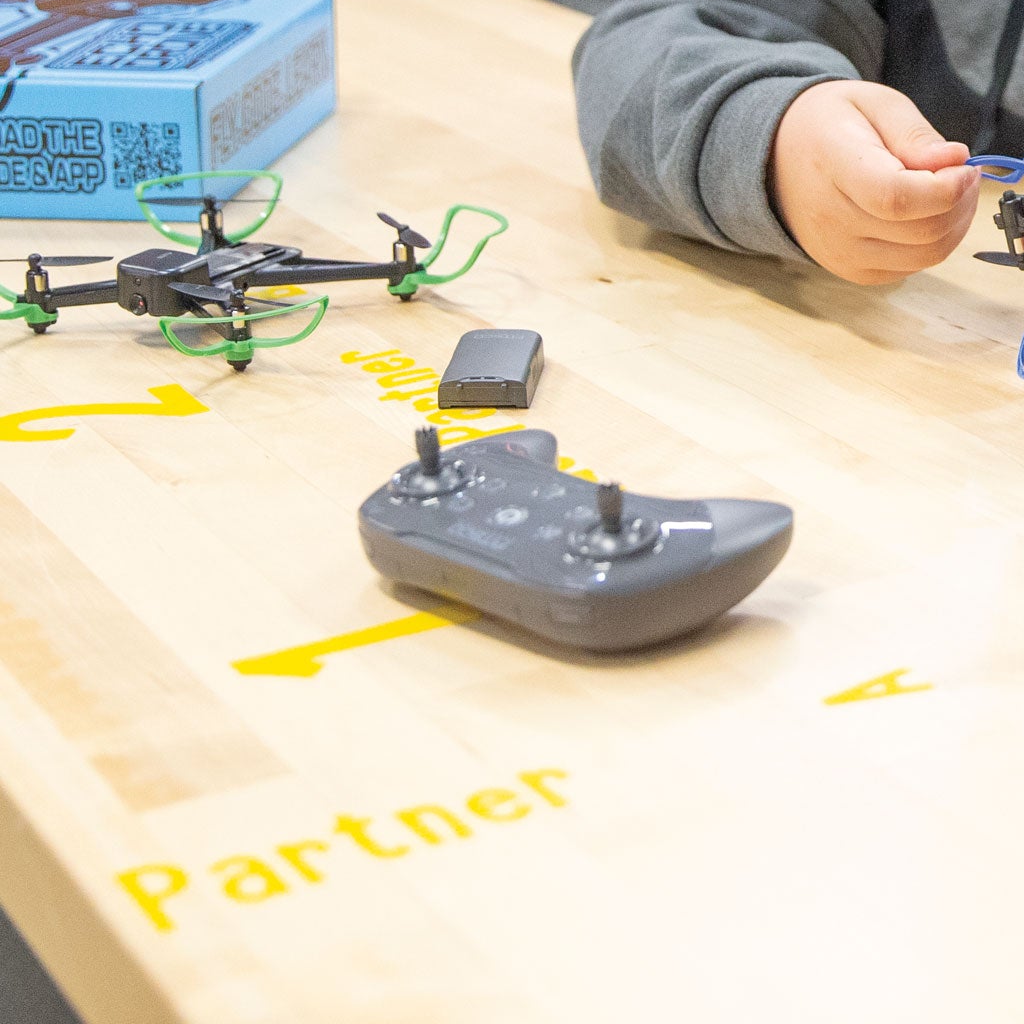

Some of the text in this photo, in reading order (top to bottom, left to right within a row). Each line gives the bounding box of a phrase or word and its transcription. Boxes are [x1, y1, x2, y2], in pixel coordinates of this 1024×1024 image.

[43, 121, 100, 154] THE
[52, 160, 101, 189] APP
[822, 667, 934, 707] A
[114, 768, 569, 935] Partner
